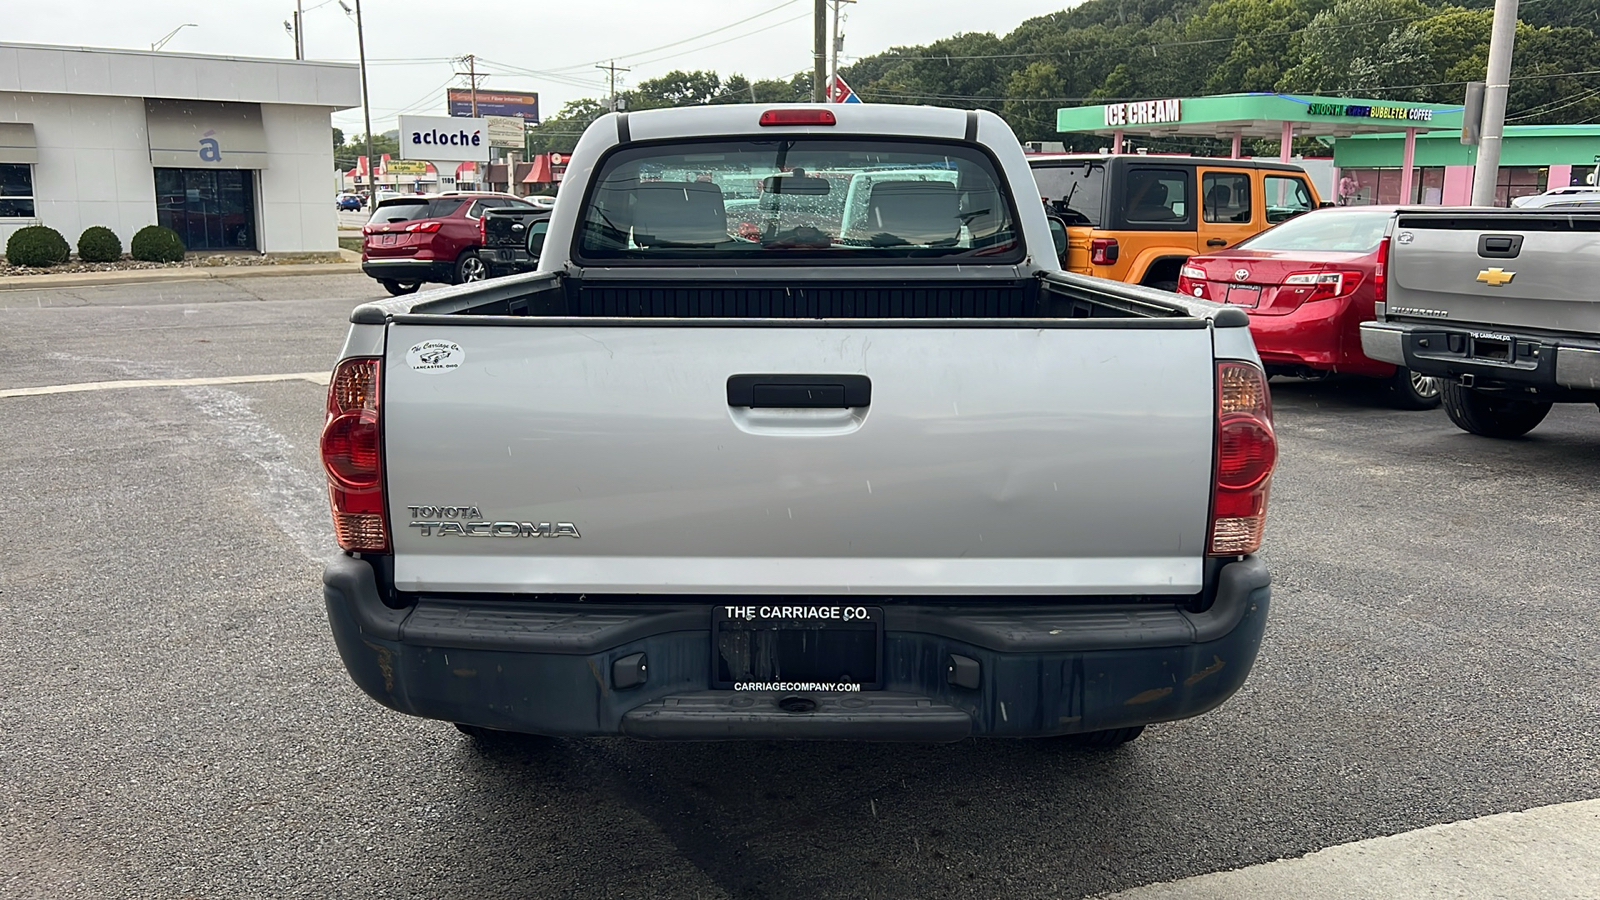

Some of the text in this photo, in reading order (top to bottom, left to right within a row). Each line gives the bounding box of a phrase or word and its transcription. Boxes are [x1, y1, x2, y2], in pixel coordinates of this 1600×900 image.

[1104, 99, 1181, 126] ICE CREAM
[1370, 106, 1408, 119] BUBBLETEA
[1409, 108, 1433, 121] COFFEE
[412, 129, 481, 147] acloché
[1391, 306, 1449, 318] SILVERADO
[1470, 331, 1480, 339] THE
[1480, 332, 1503, 341] CARRIAGE
[423, 342, 449, 350] Carriage
[407, 505, 483, 519] TOYOTA
[409, 521, 582, 539] TACOMA
[724, 605, 871, 621] THE CARRIAGE CO.
[734, 682, 861, 692] CARRIAGECOMPANY.COM
